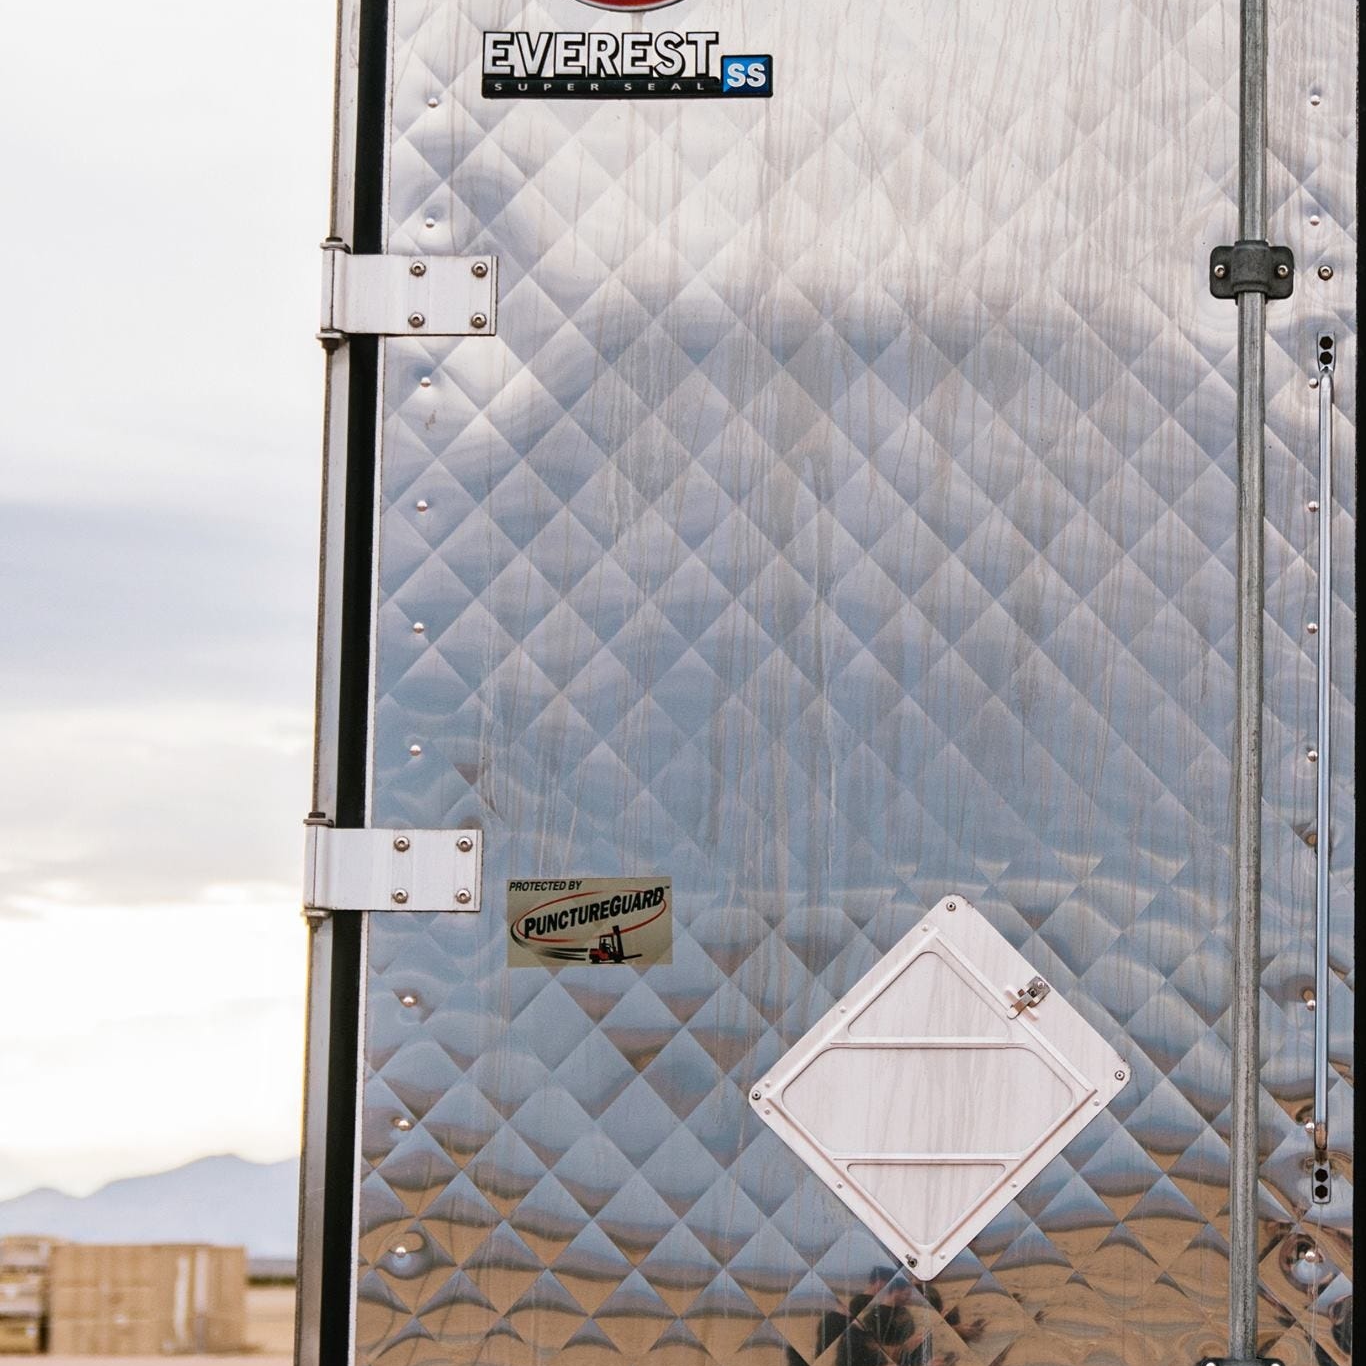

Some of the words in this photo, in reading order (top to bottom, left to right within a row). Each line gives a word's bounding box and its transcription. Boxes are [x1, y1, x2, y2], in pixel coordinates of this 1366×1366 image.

[483, 31, 719, 77] EVEREST
[727, 63, 766, 87] SS
[494, 82, 600, 91] SUPER
[624, 82, 705, 91] SEAL
[509, 881, 567, 892] PROTECTED
[568, 880, 582, 891] BY
[524, 887, 665, 939] PUNCTUREGUARD
